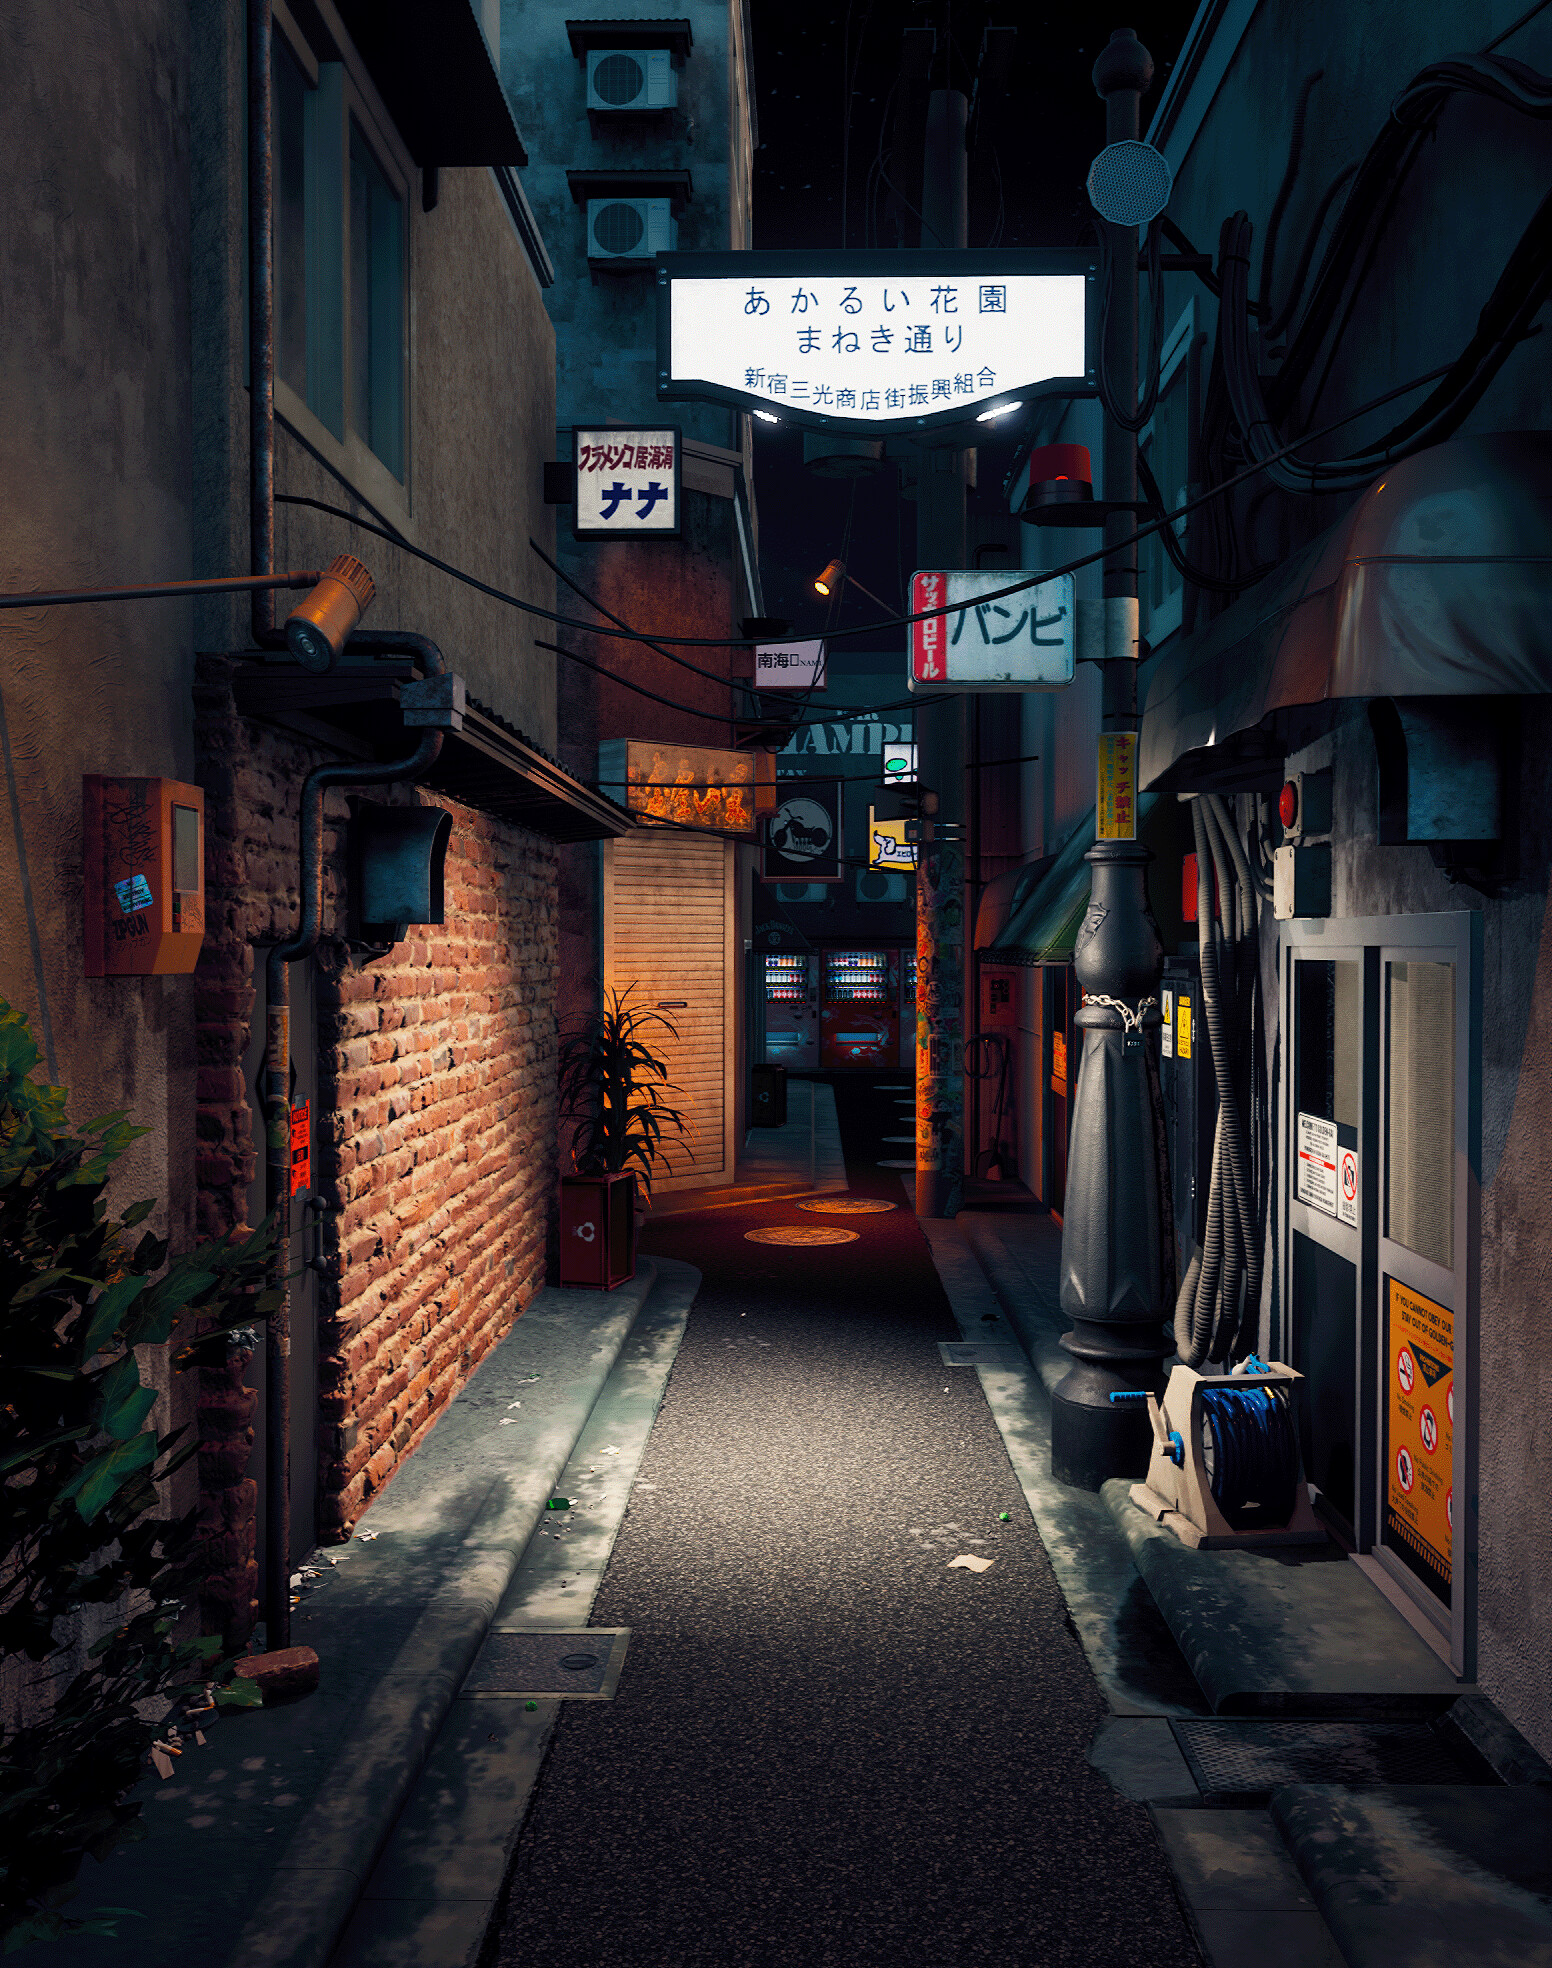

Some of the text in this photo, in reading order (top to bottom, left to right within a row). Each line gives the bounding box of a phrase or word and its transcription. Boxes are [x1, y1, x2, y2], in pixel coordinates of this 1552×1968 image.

[743, 285, 1007, 315] あかるい花園
[796, 324, 963, 353] まねき通り
[744, 366, 997, 410] 新宿三光商店街振興組合
[599, 481, 669, 520] ナナ
[951, 602, 1067, 646] バンビ
